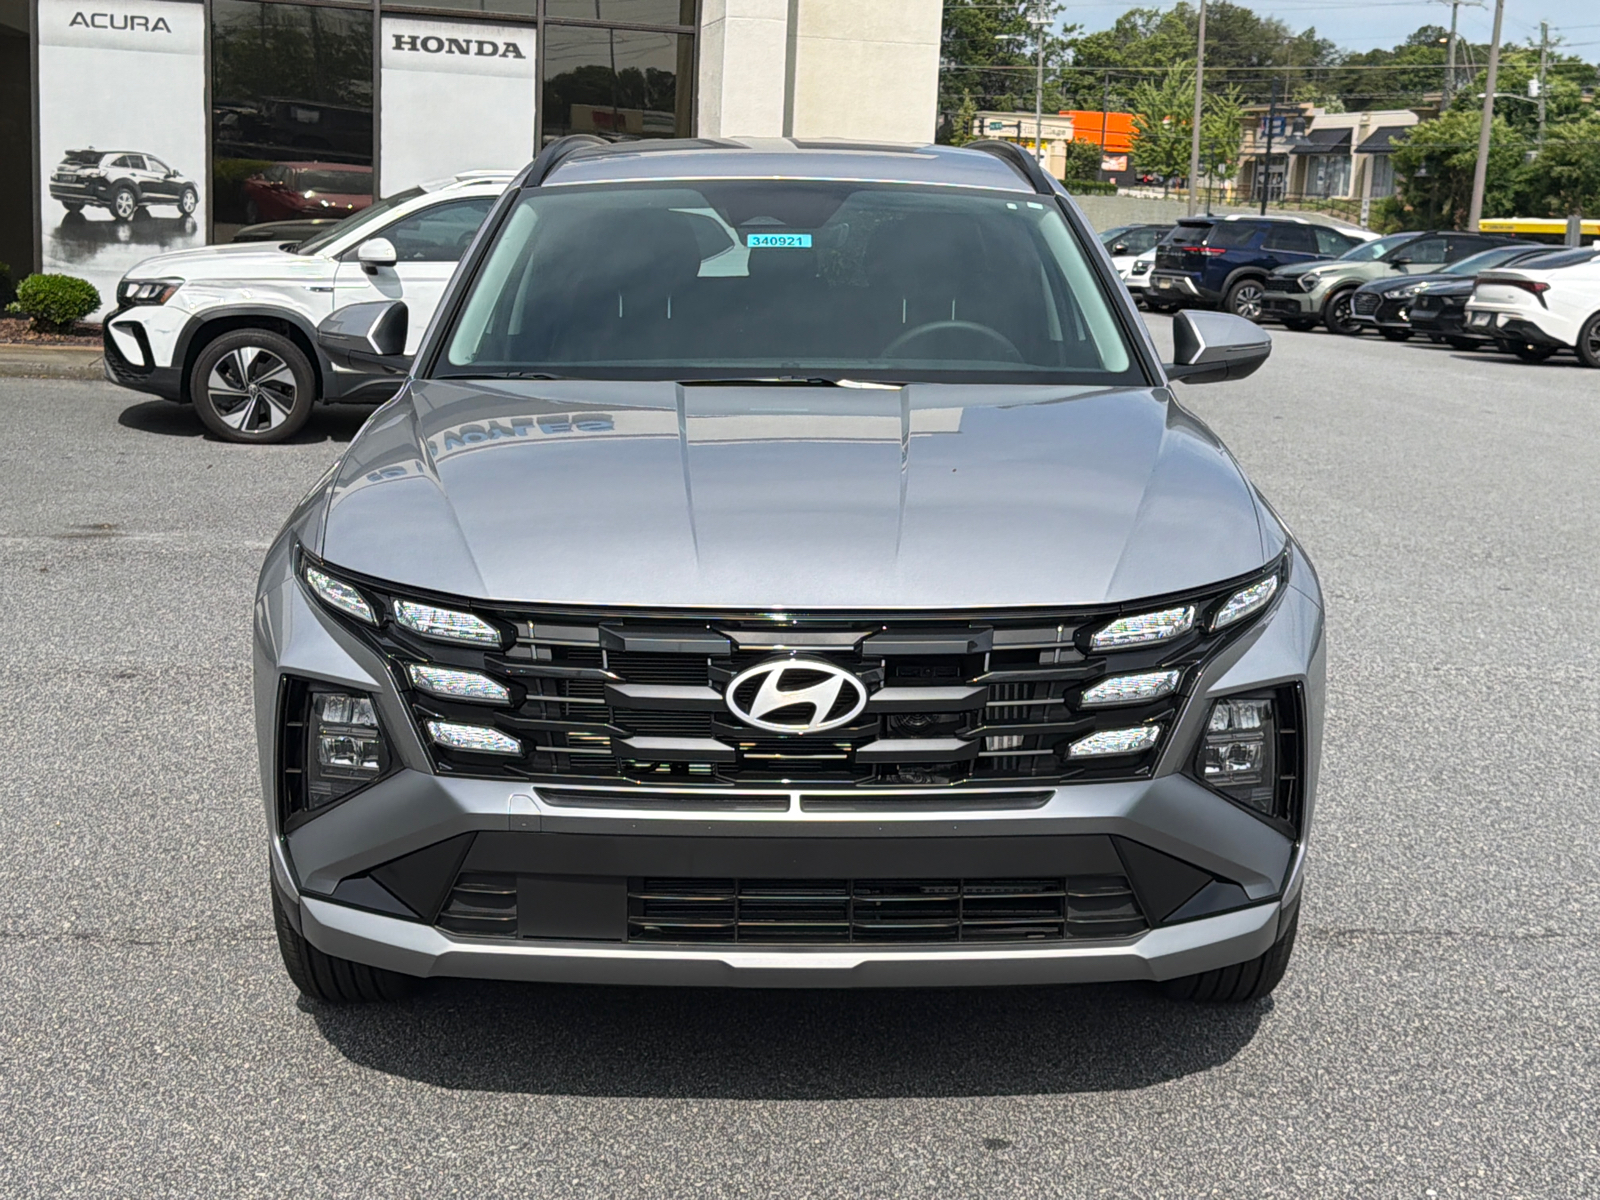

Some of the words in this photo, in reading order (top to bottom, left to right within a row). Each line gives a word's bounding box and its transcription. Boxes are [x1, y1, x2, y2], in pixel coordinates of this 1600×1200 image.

[69, 12, 172, 33] ACURA
[392, 34, 526, 59] HONDA
[752, 236, 802, 246] 340921
